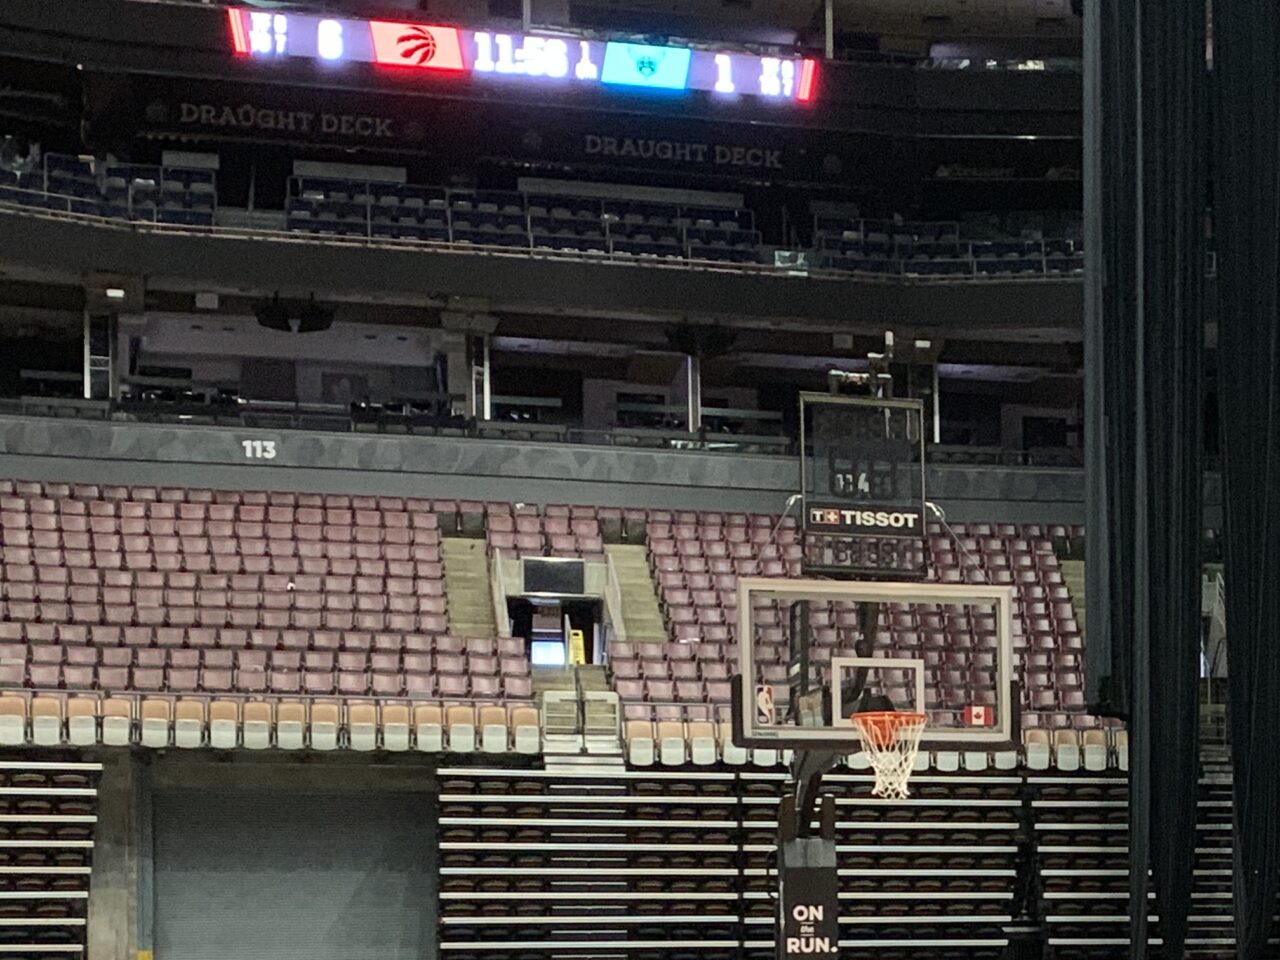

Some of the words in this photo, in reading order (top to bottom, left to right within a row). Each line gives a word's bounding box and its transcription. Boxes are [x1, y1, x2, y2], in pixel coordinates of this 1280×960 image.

[715, 54, 735, 92] 1
[180, 102, 313, 131] DRAUGHT
[321, 113, 393, 137] DECK
[585, 134, 707, 162] DRAUGHT
[714, 146, 783, 168] DECK
[242, 440, 276, 458] 113
[841, 510, 918, 528] TISSOT
[793, 905, 824, 921] ON
[800, 925, 815, 934] the
[787, 937, 838, 953] RUN.
